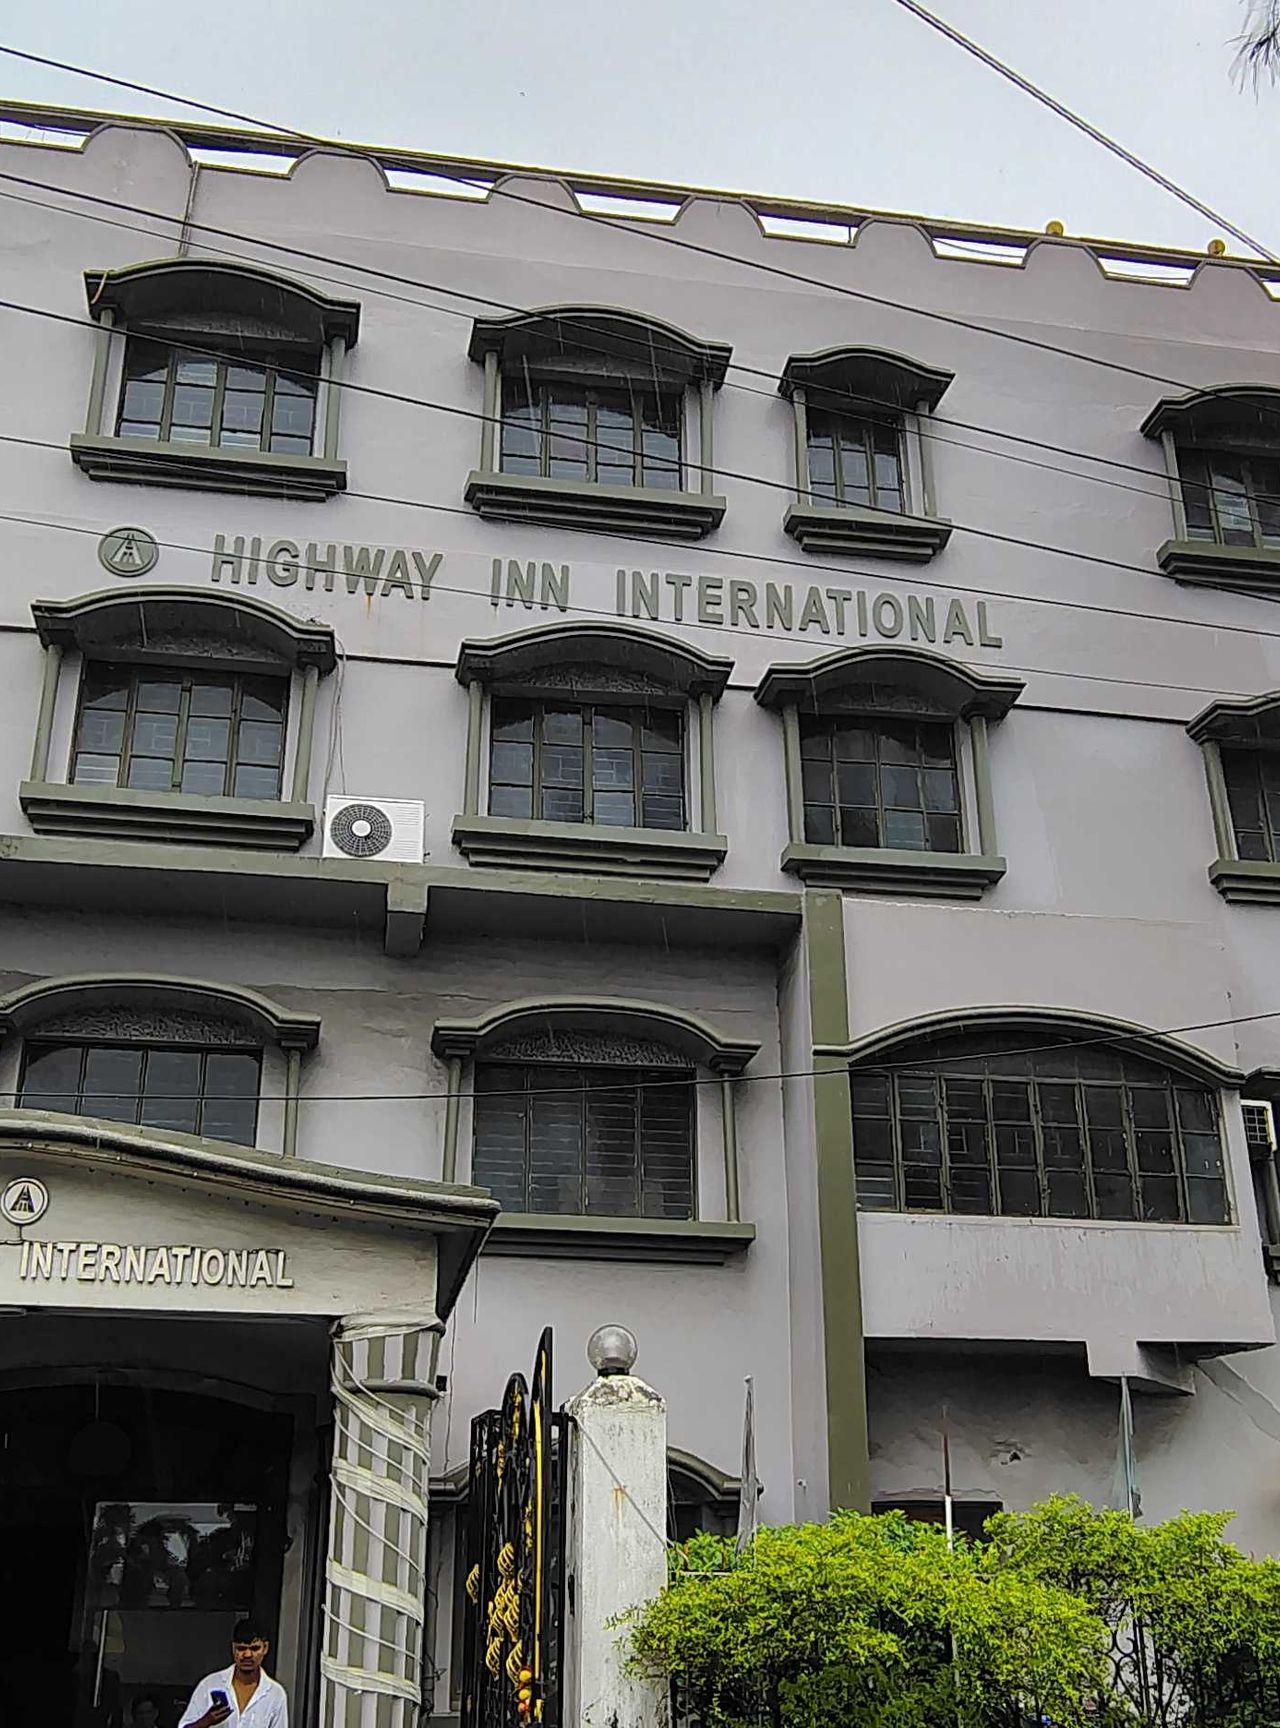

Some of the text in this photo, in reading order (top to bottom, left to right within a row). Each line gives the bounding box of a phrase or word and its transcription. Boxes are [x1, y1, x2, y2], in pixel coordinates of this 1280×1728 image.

[211, 534, 1004, 647] HIGHWAY INN INTERNATIONAL
[19, 1241, 294, 1287] INTERNATIONAL
